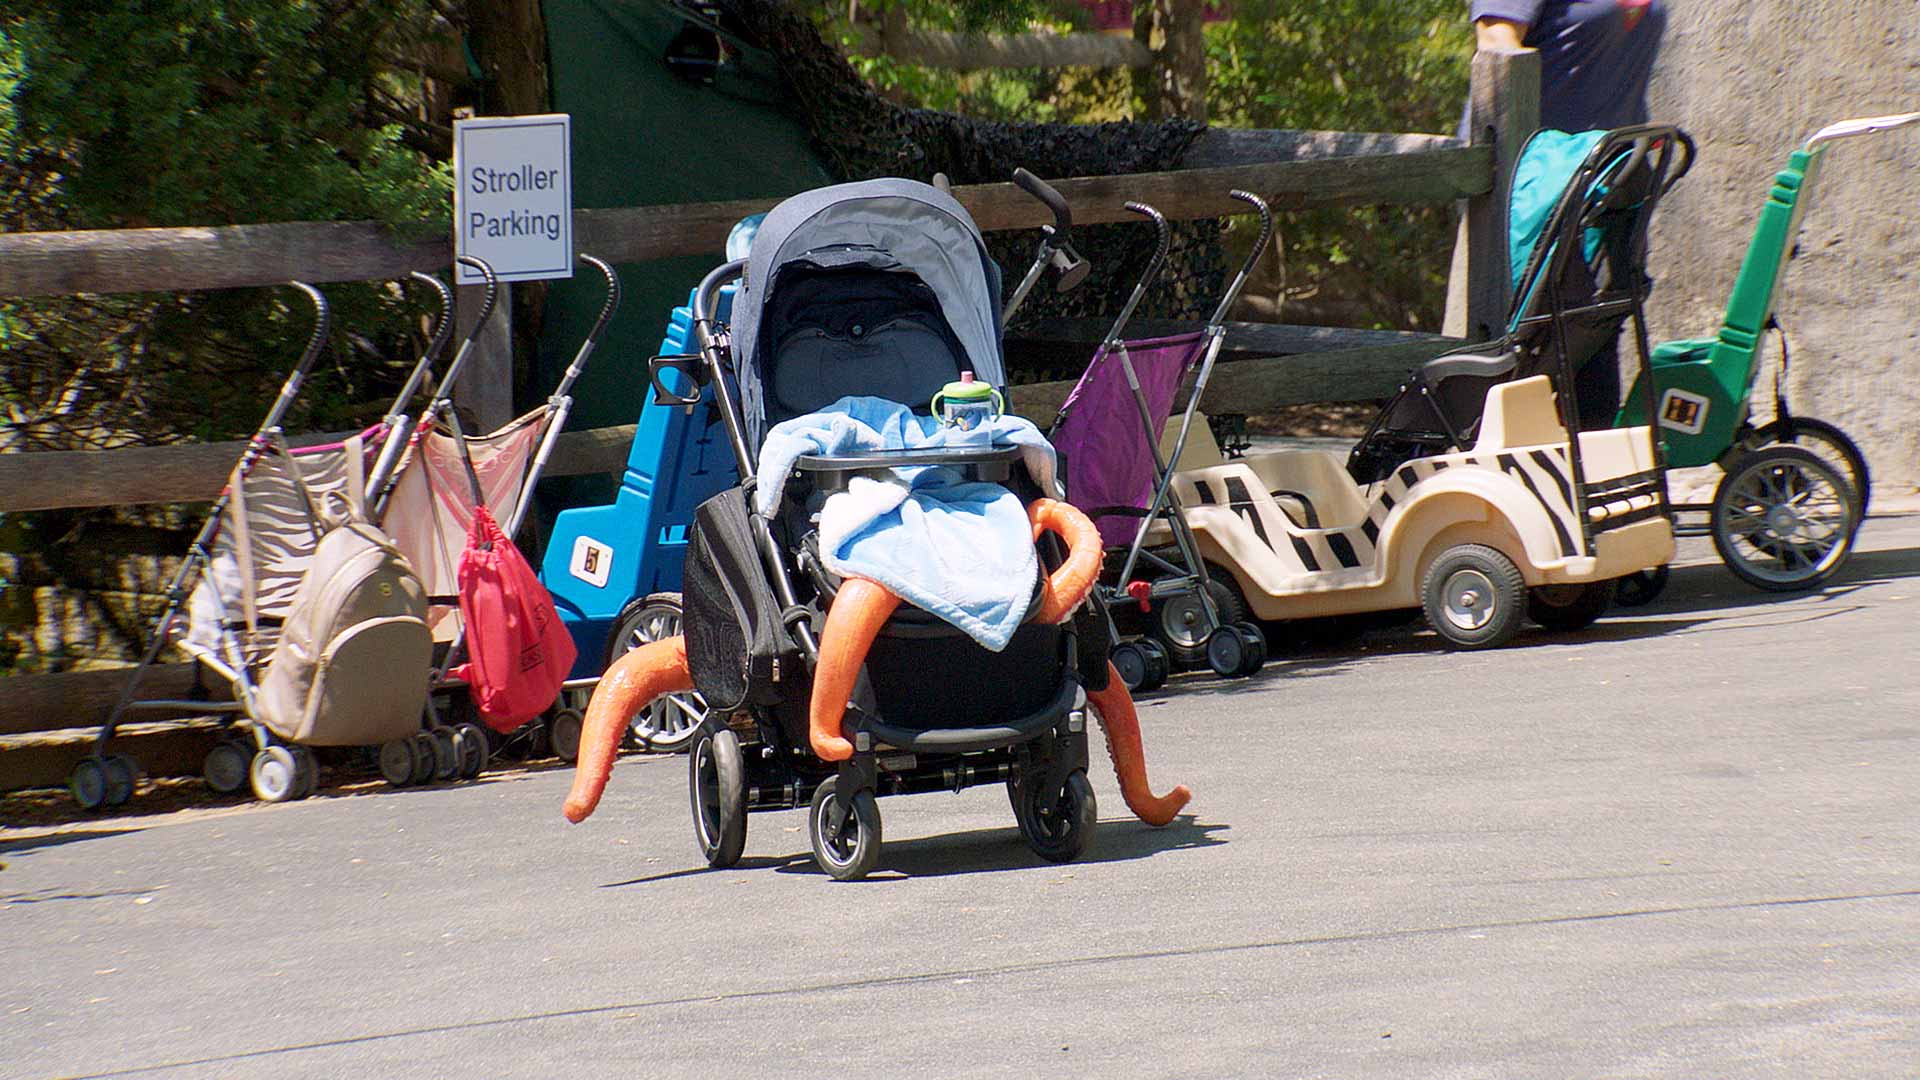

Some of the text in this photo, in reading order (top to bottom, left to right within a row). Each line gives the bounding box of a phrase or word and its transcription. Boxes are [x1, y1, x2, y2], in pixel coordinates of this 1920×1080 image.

[471, 164, 558, 194] Stroller
[470, 210, 560, 241] Parking
[586, 547, 599, 572] 5
